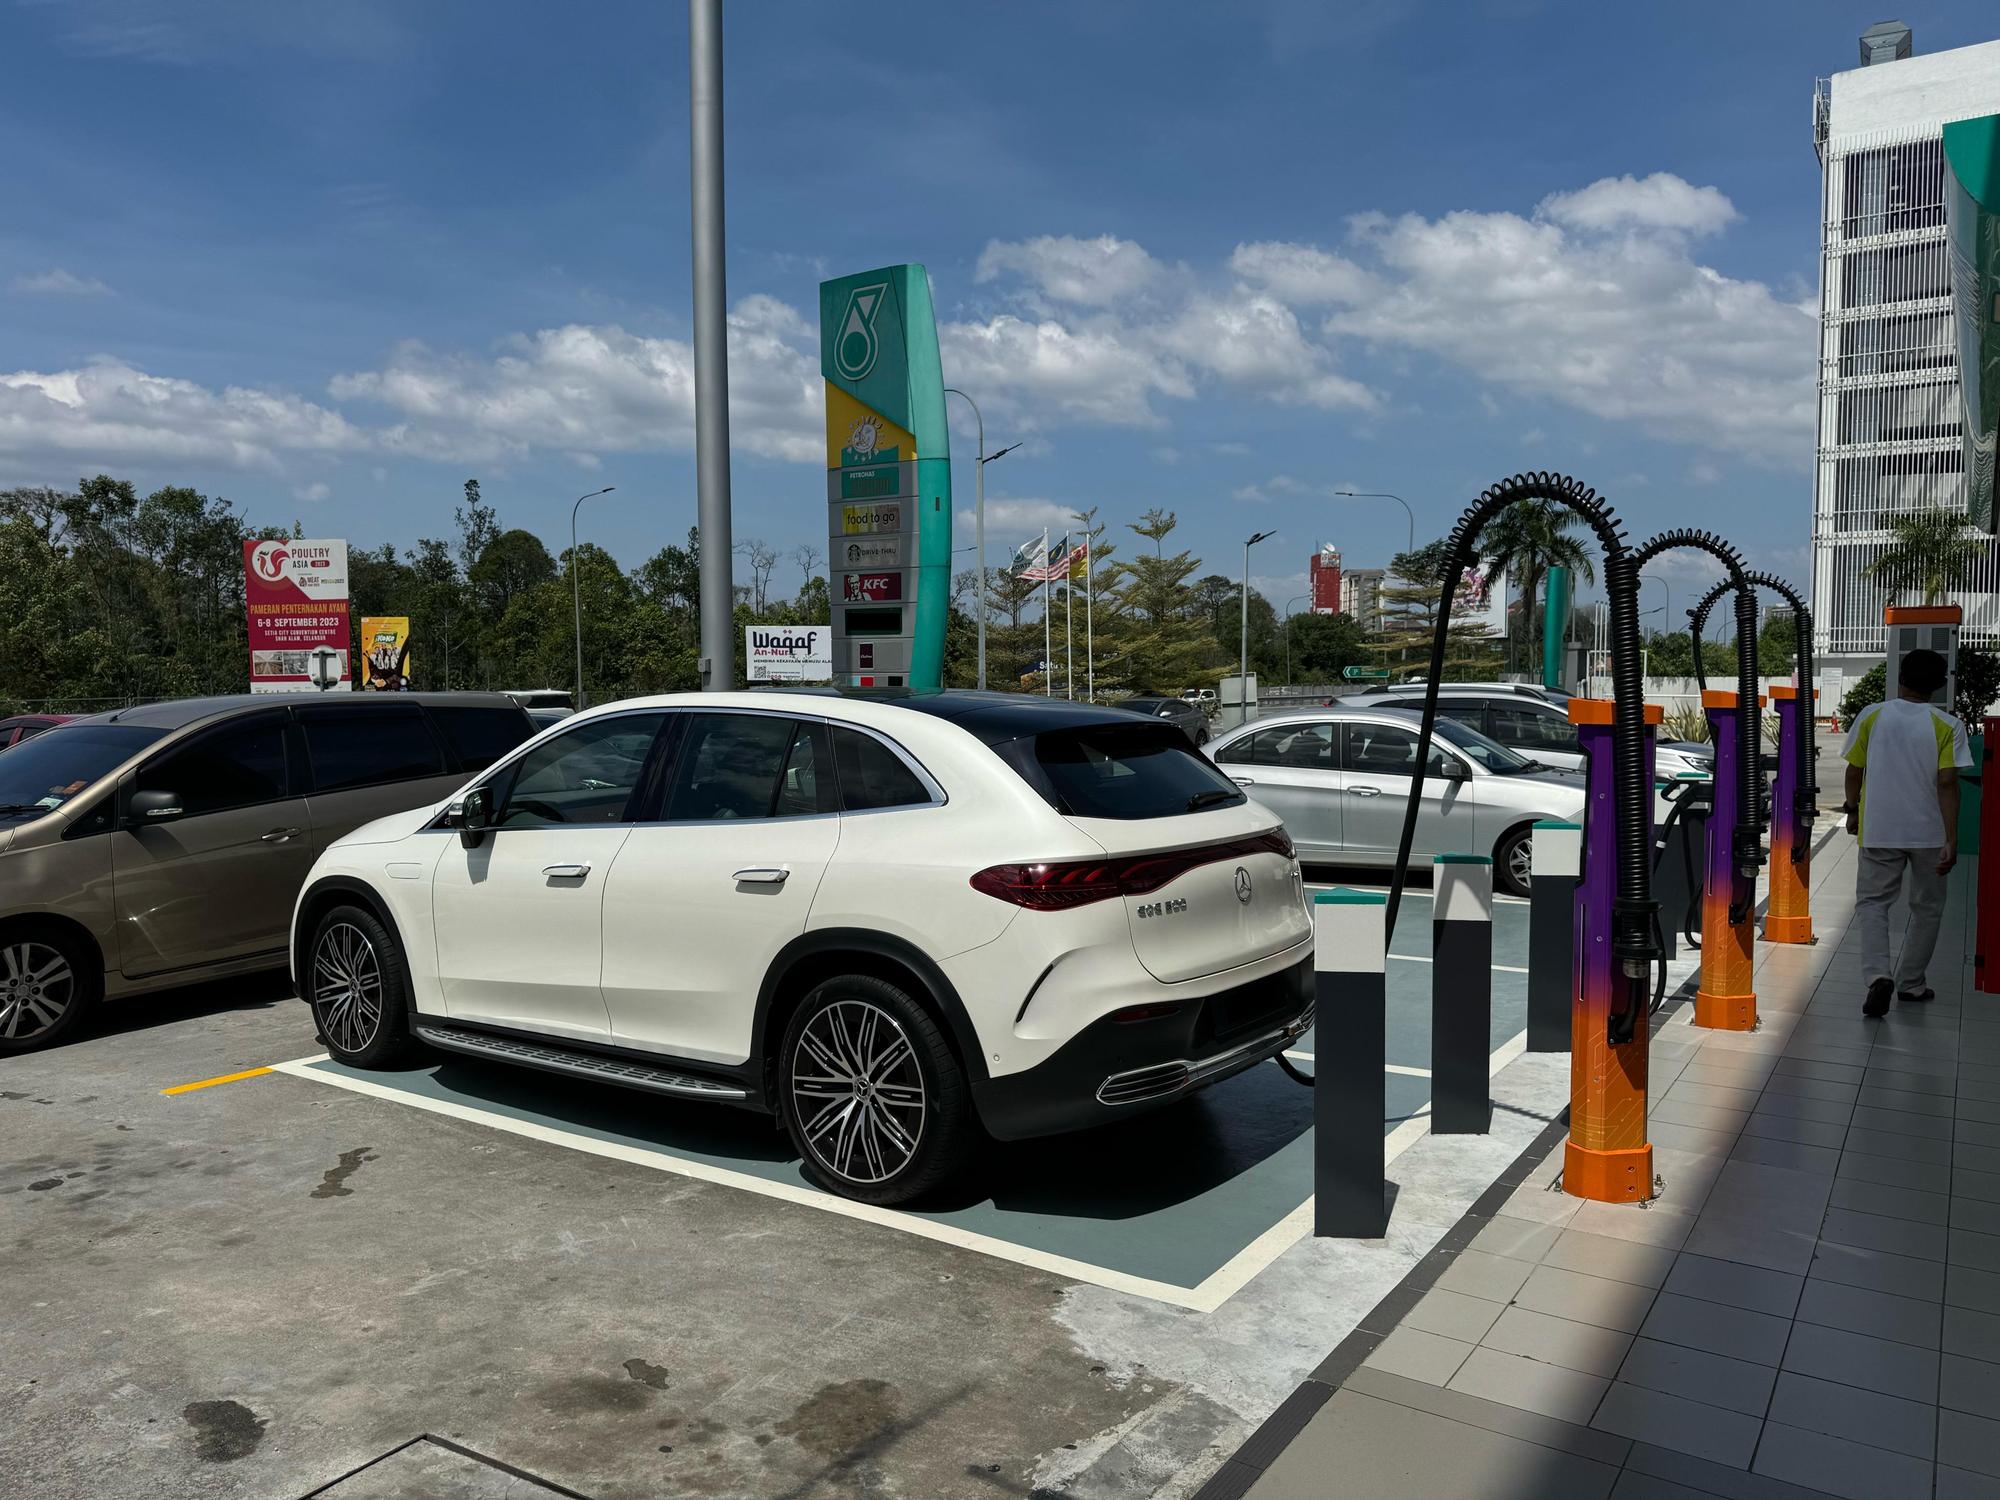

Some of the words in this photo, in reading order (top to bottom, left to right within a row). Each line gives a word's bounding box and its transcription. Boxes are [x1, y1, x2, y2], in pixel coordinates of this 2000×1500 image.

[847, 512, 868, 525] food
[870, 513, 880, 523] to
[882, 513, 895, 525] go
[291, 547, 330, 559] POULTRY
[292, 560, 309, 569] ASIA
[862, 578, 889, 590] KFC
[250, 604, 281, 615] PAMERAN
[281, 603, 328, 614] PENTERNAKAN
[328, 602, 347, 614] AYAM
[257, 618, 271, 628] 6-8
[274, 617, 318, 627] SEPTEMBER
[319, 617, 339, 627] 2023
[752, 629, 818, 655] Waqaf
[753, 648, 789, 656] An-Nur
